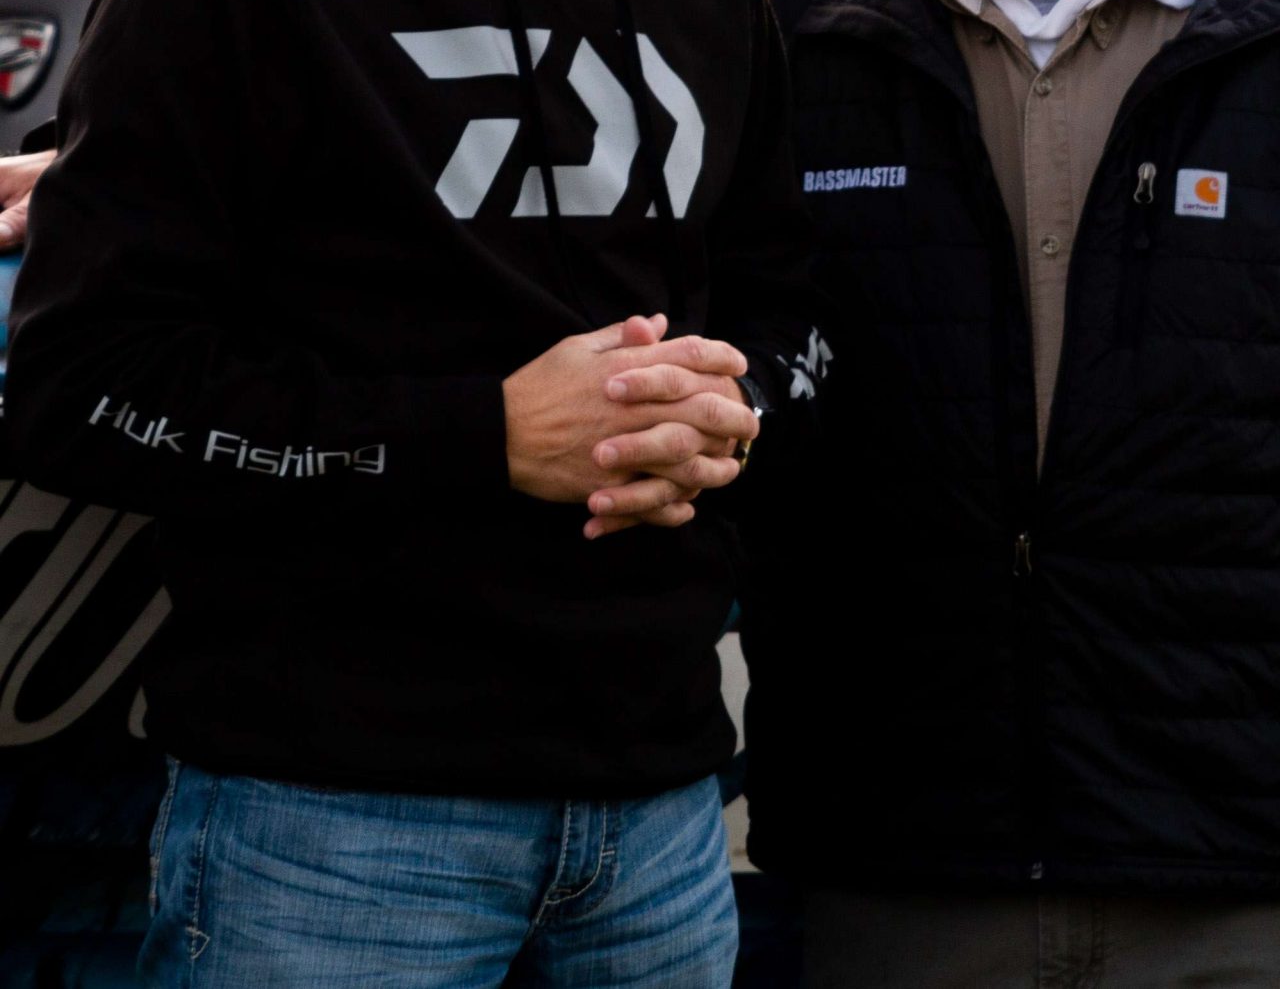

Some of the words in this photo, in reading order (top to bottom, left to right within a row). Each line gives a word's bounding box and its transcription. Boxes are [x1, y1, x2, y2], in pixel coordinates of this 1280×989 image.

[803, 166, 907, 192] BASSMASTER
[88, 395, 187, 453] Huk
[203, 430, 386, 478] Fishing
